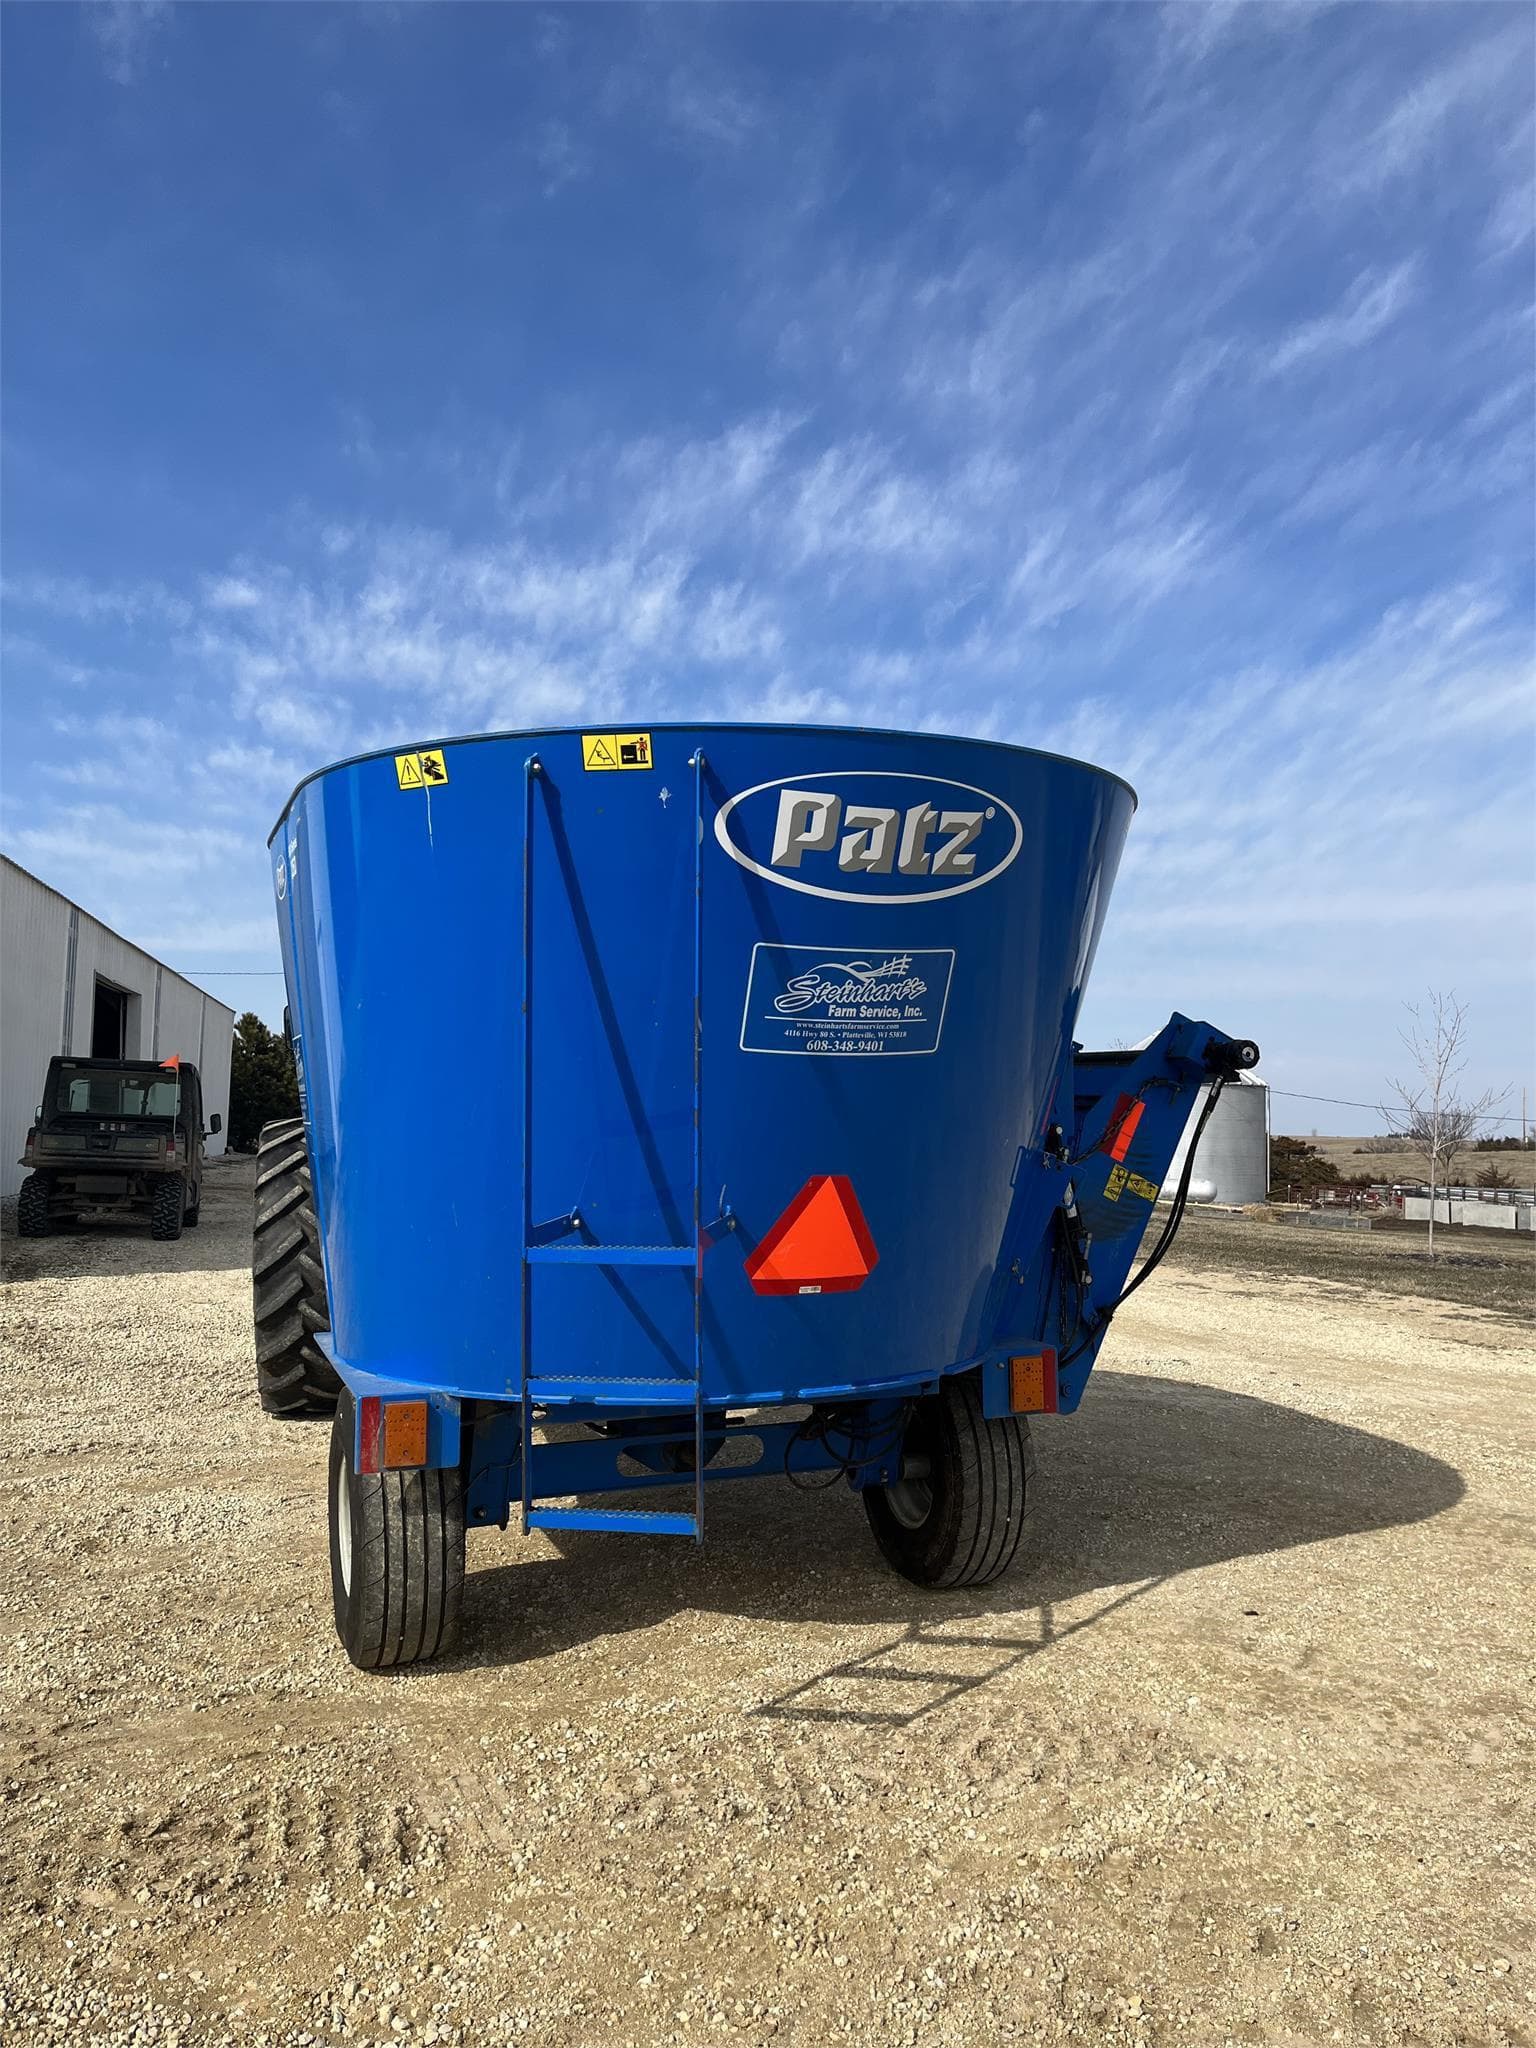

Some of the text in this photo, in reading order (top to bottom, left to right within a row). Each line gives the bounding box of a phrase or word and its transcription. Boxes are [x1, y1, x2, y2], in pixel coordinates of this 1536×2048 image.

[774, 974, 928, 1013] Steinhart's
[828, 1004, 922, 1019] Farm Service, Inc.
[796, 1022, 900, 1030] www.steinhartsfarmservice.com
[784, 1029, 801, 1037] 4116
[802, 1030, 818, 1039] Hwy
[806, 1040, 884, 1052] 608-348-9401
